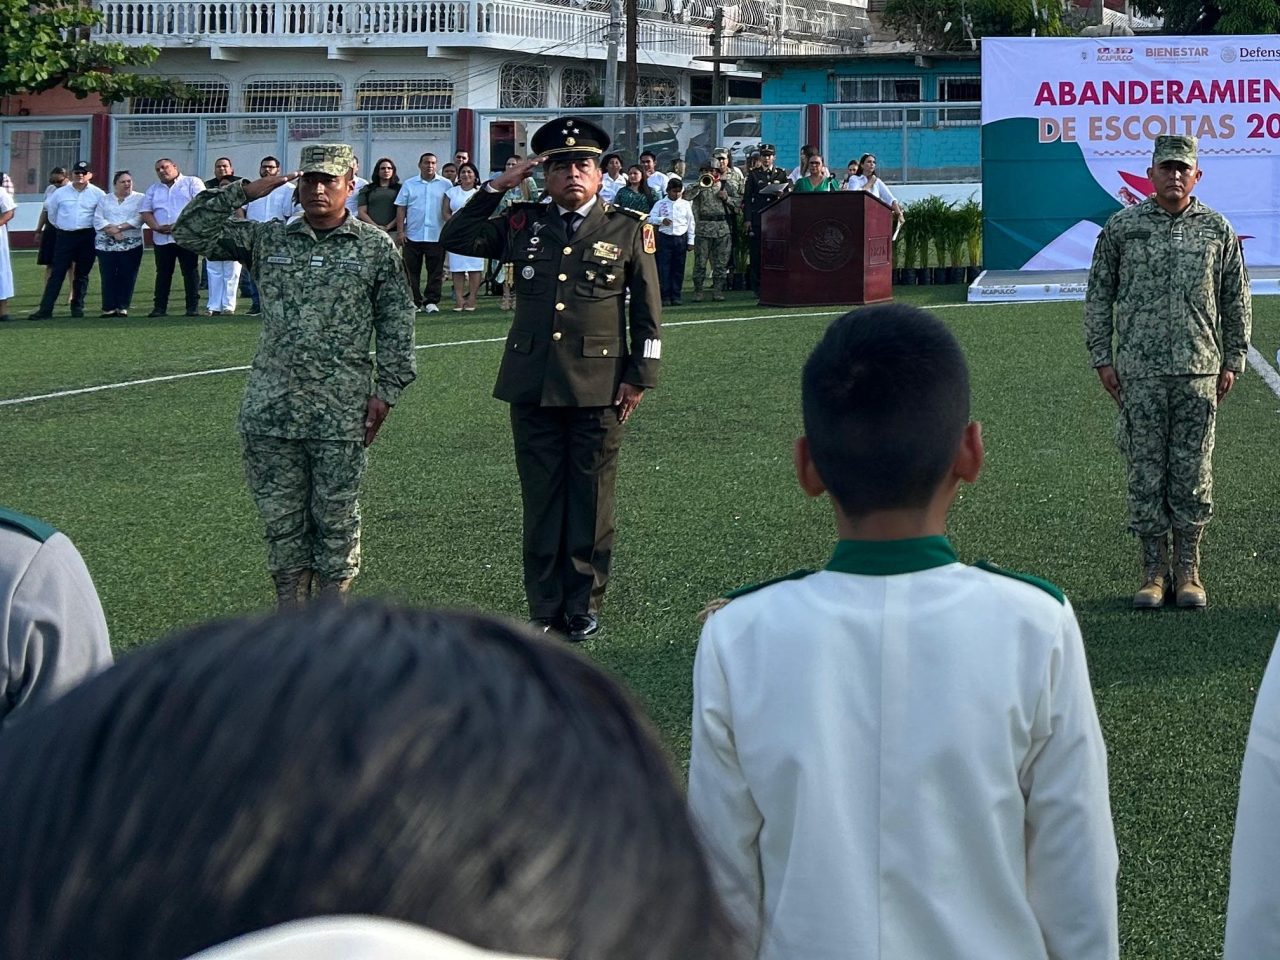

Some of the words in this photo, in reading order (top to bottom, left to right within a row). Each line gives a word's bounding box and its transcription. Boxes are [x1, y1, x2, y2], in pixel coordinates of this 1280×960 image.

[1145, 47, 1209, 57] BIENESTAR
[1039, 115, 1077, 143] DE
[1089, 115, 1235, 141] ESCOLTAS
